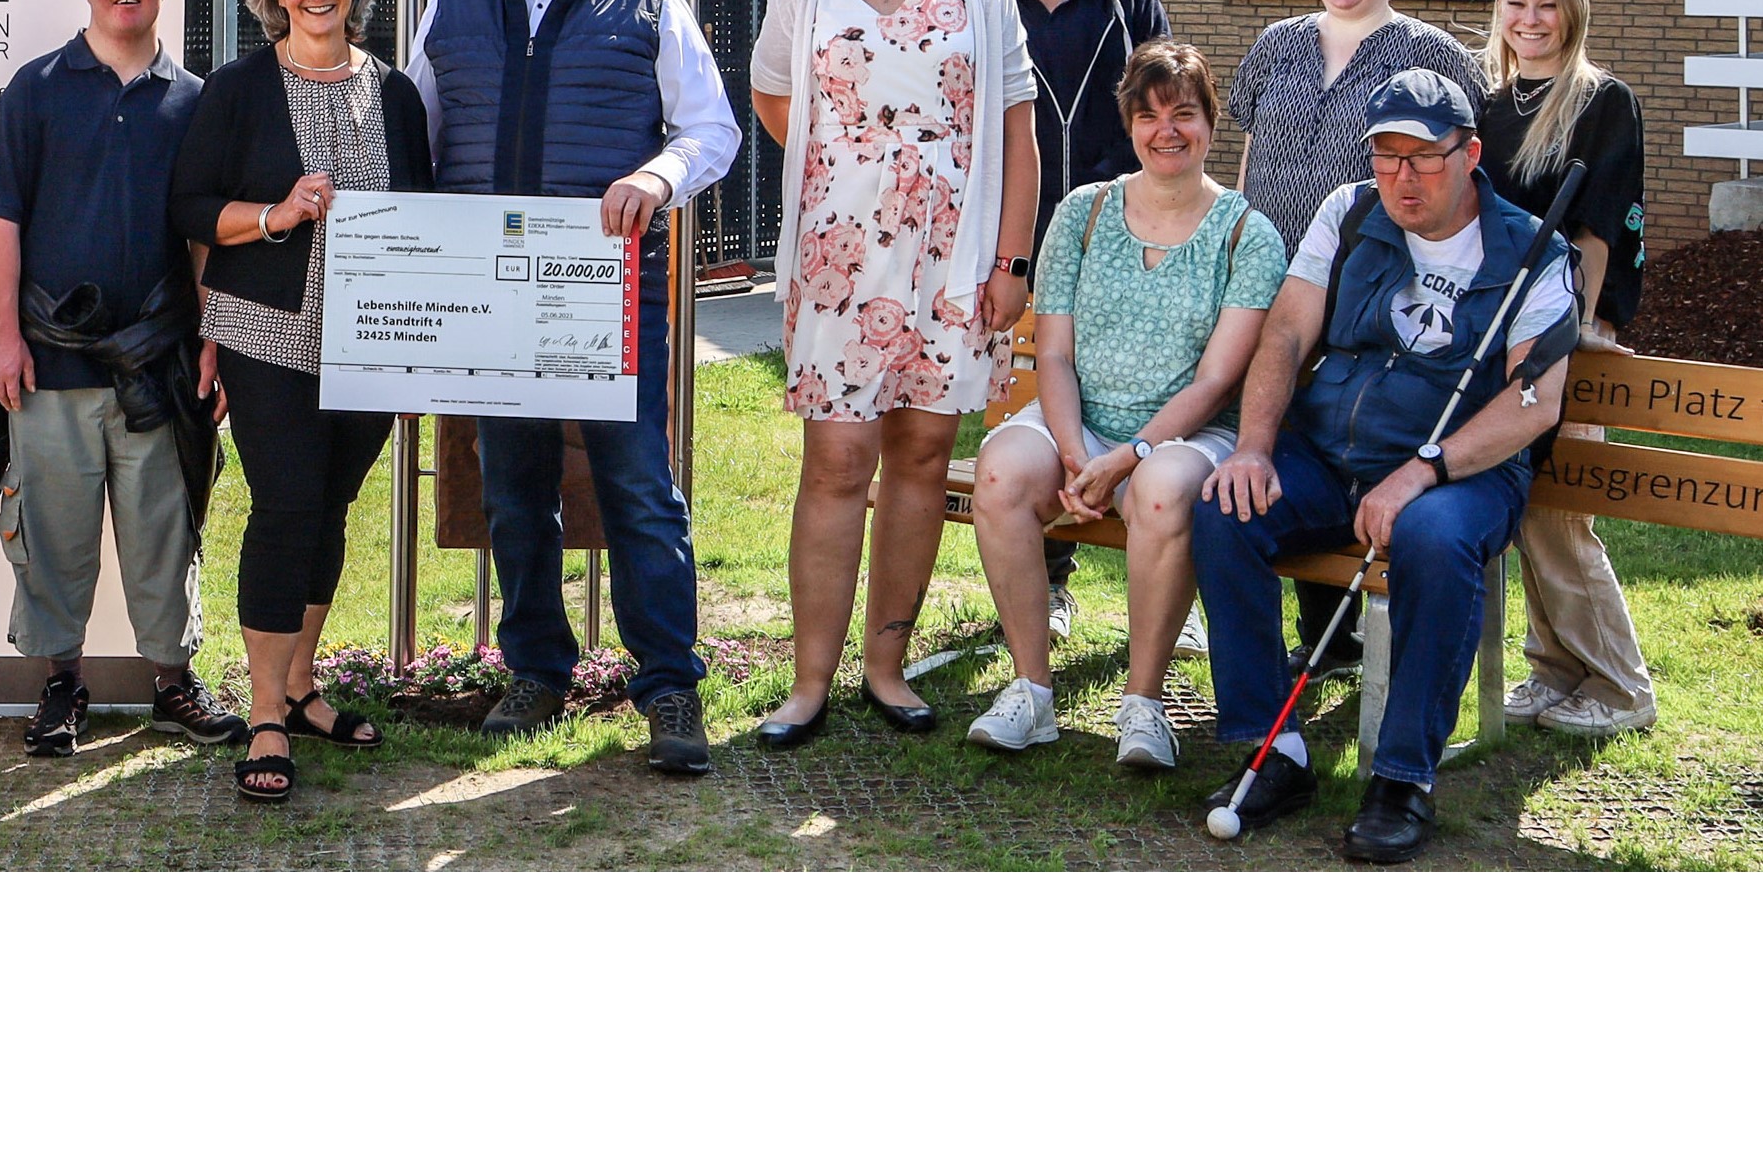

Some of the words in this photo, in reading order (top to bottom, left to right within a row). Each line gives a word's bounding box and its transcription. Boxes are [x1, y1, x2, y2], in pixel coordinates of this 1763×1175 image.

[358, 205, 398, 219] Verrechnung
[543, 262, 615, 280] 20.000,00
[1422, 273, 1467, 303] COAS
[357, 300, 423, 313] Lebenshilfe
[425, 301, 469, 314] Minden
[471, 304, 493, 314] e.V.
[356, 316, 379, 326] Alte
[381, 316, 433, 328] Sandtrift
[435, 318, 443, 328] 4
[356, 330, 391, 341] 32425
[394, 331, 437, 342] Minden
[1573, 372, 1631, 408] ein
[1649, 378, 1745, 421] Platz
